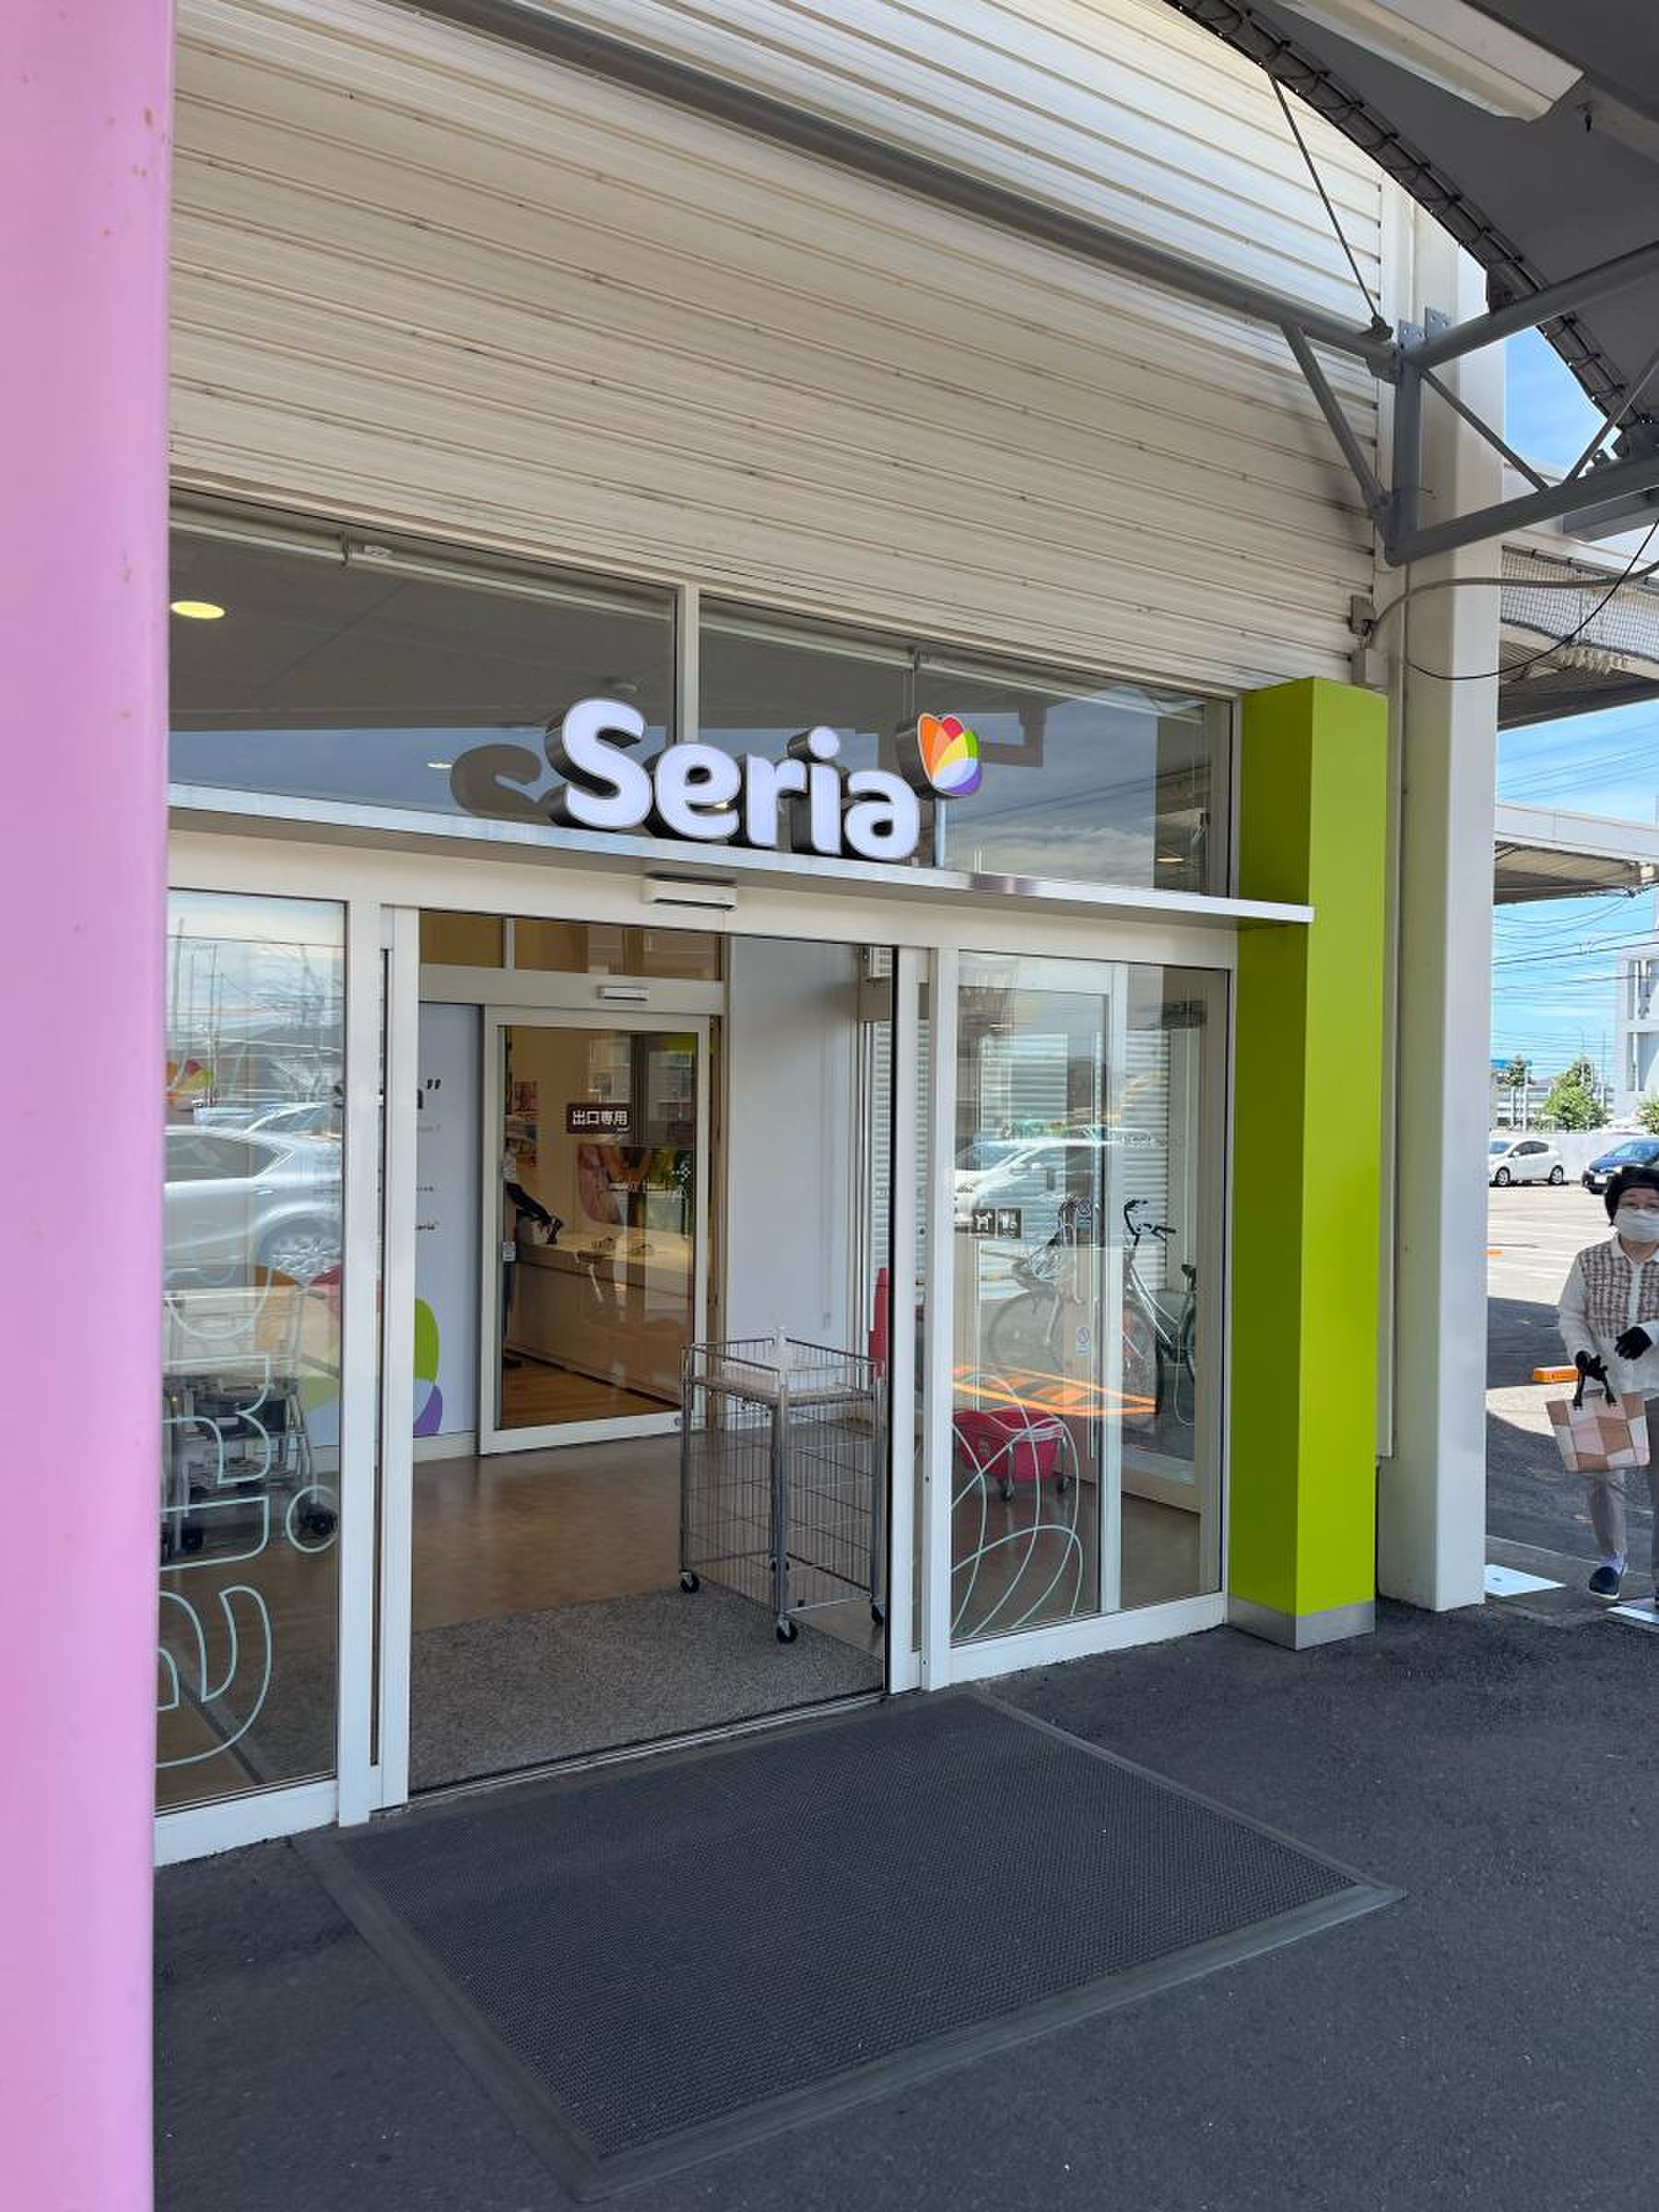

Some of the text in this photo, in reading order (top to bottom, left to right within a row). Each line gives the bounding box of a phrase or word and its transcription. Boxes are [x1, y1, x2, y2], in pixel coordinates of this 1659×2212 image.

[559, 698, 921, 861] Seria
[571, 1109, 629, 1126] 出口専用
